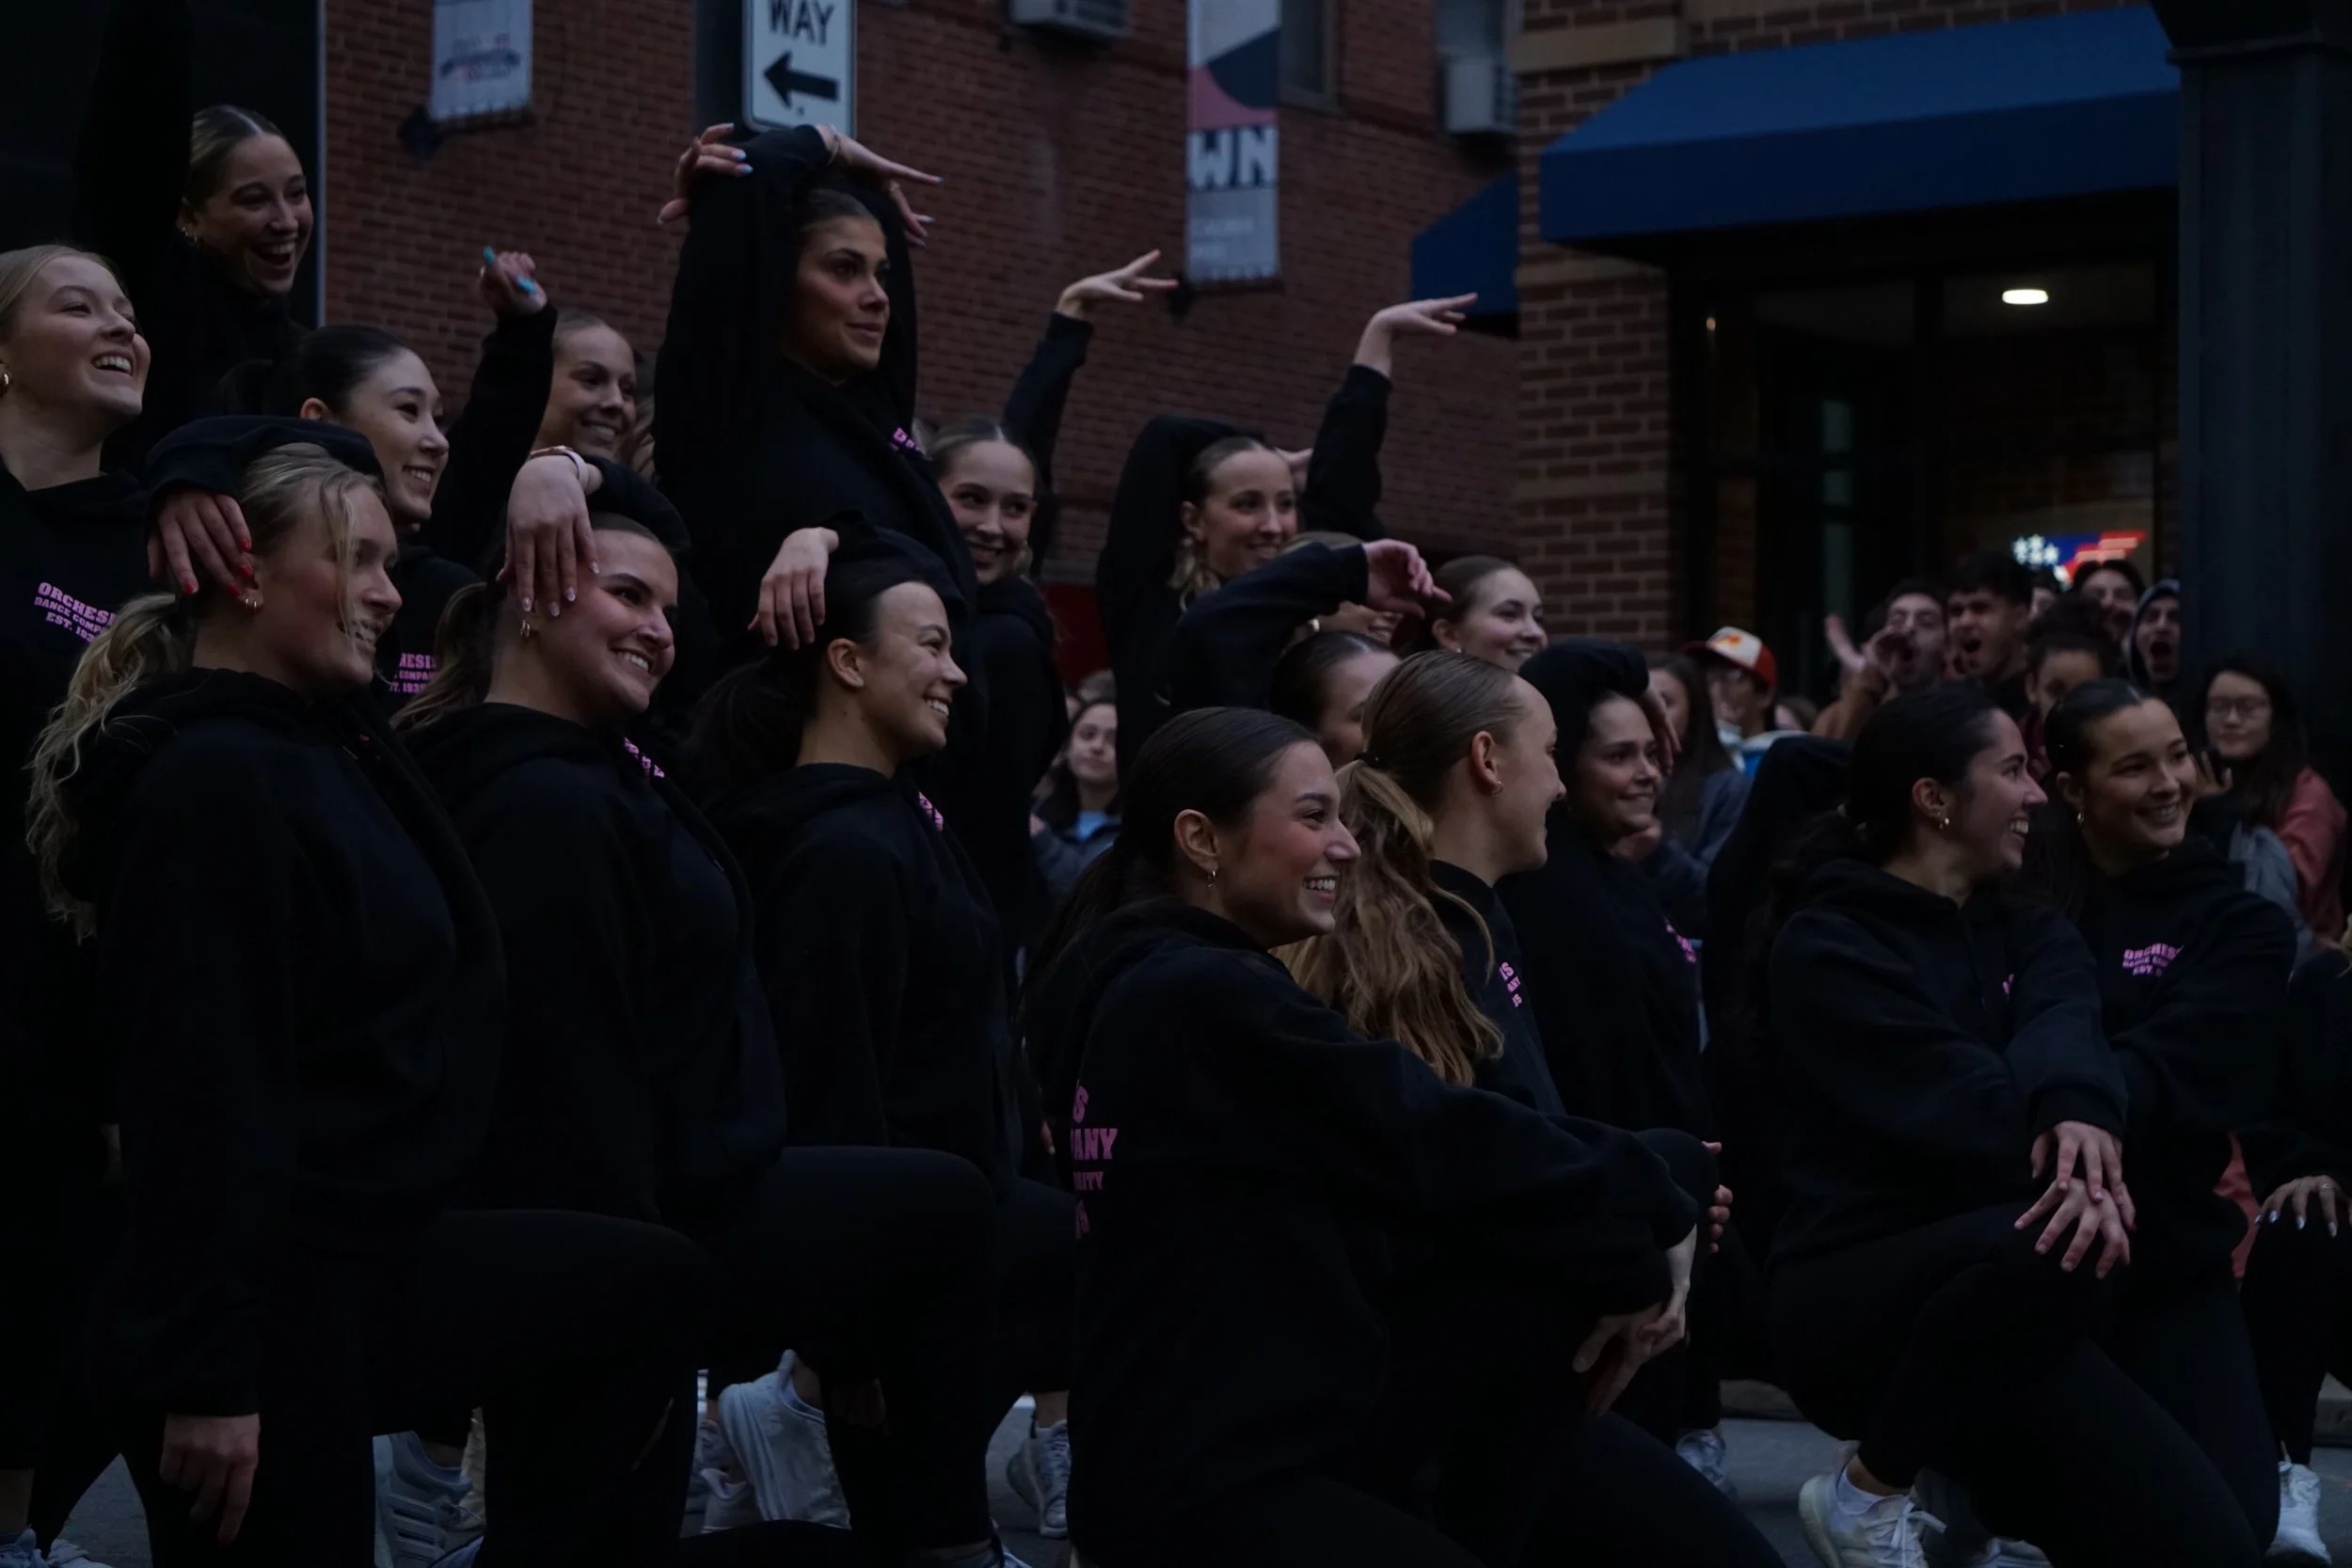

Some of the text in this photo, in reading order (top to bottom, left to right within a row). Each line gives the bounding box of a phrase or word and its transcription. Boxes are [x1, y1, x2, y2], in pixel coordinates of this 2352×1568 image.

[769, 0, 835, 45] WAY
[34, 595, 109, 633] DANCE COMP
[45, 610, 97, 643] EST. 193
[1070, 1128, 1119, 1161] ANY
